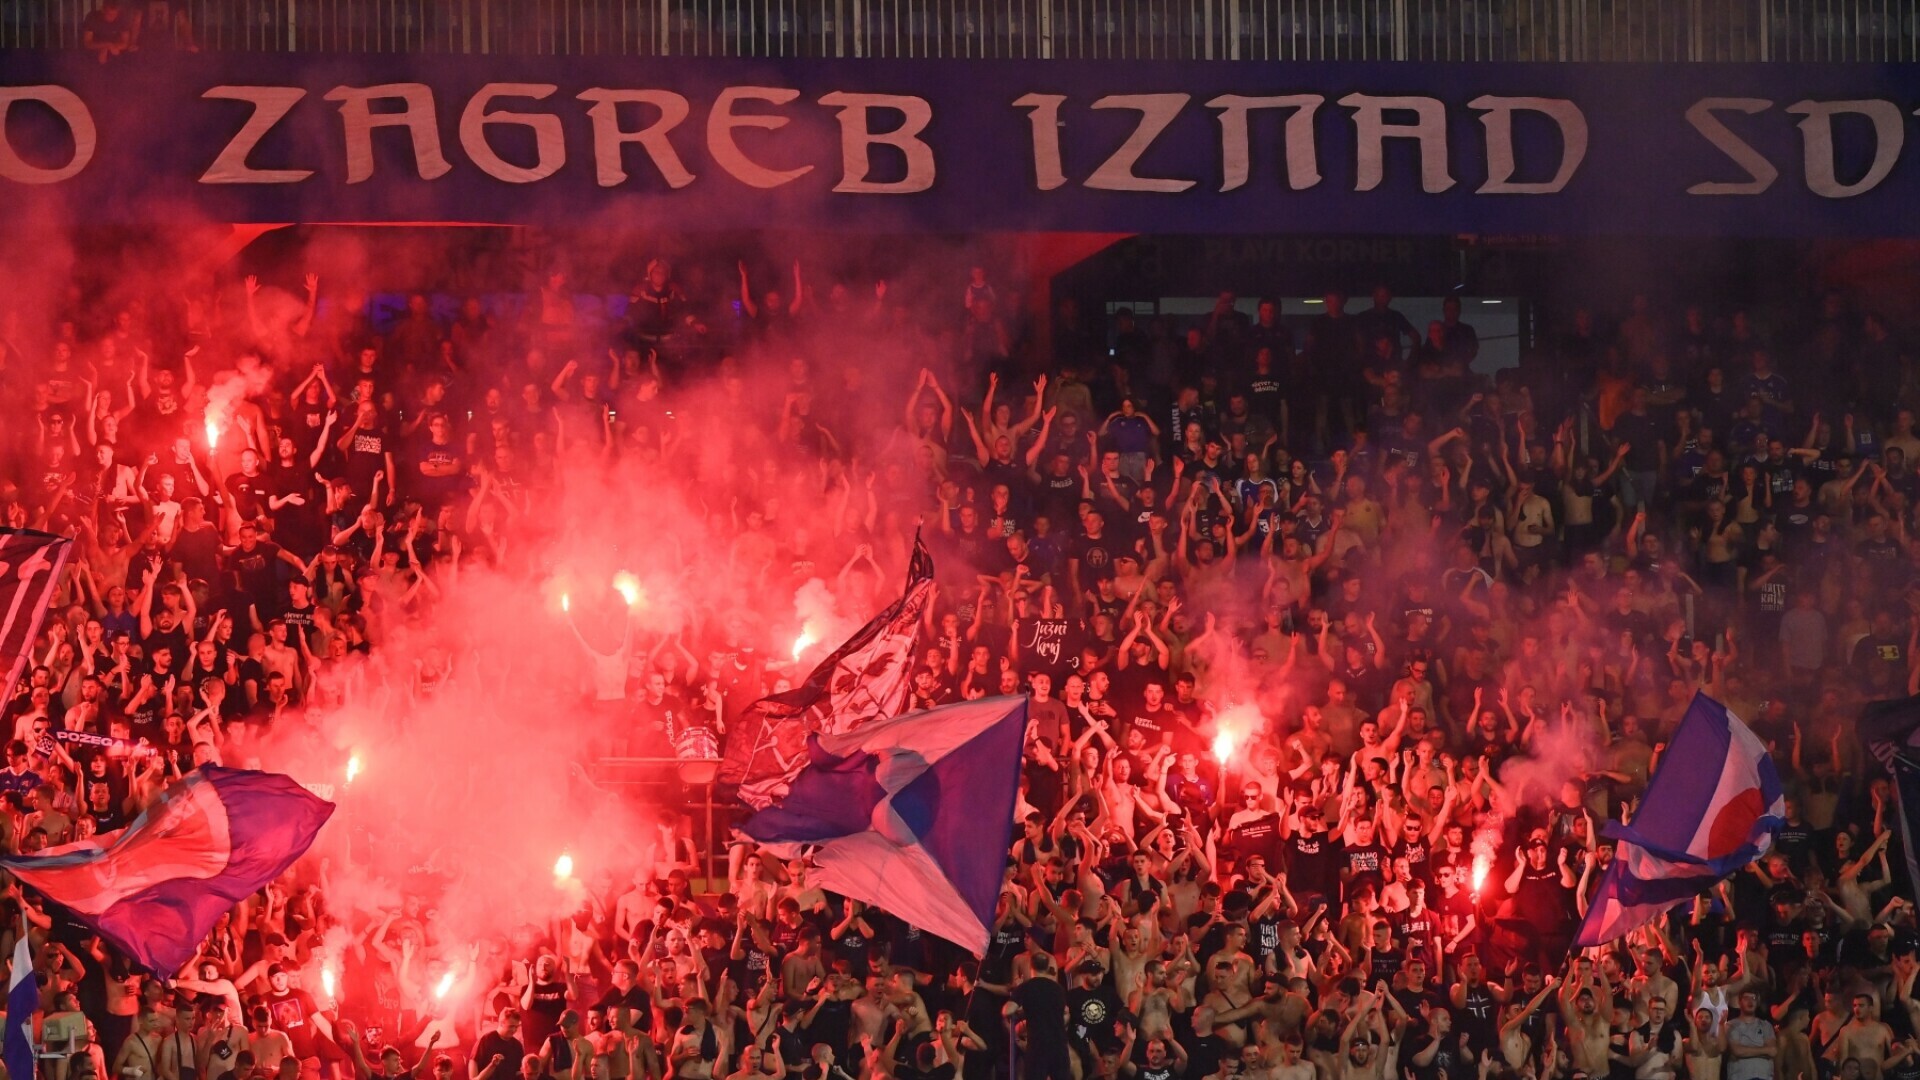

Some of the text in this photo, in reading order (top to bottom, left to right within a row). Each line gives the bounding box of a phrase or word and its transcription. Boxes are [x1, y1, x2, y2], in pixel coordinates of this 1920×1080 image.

[198, 82, 938, 194] ZAGREB
[1011, 91, 1590, 196] IZNAD
[1205, 239, 1412, 264] PLAVI KORNER
[1021, 620, 1068, 649] Južni
[56, 731, 125, 748] POŽEGA
